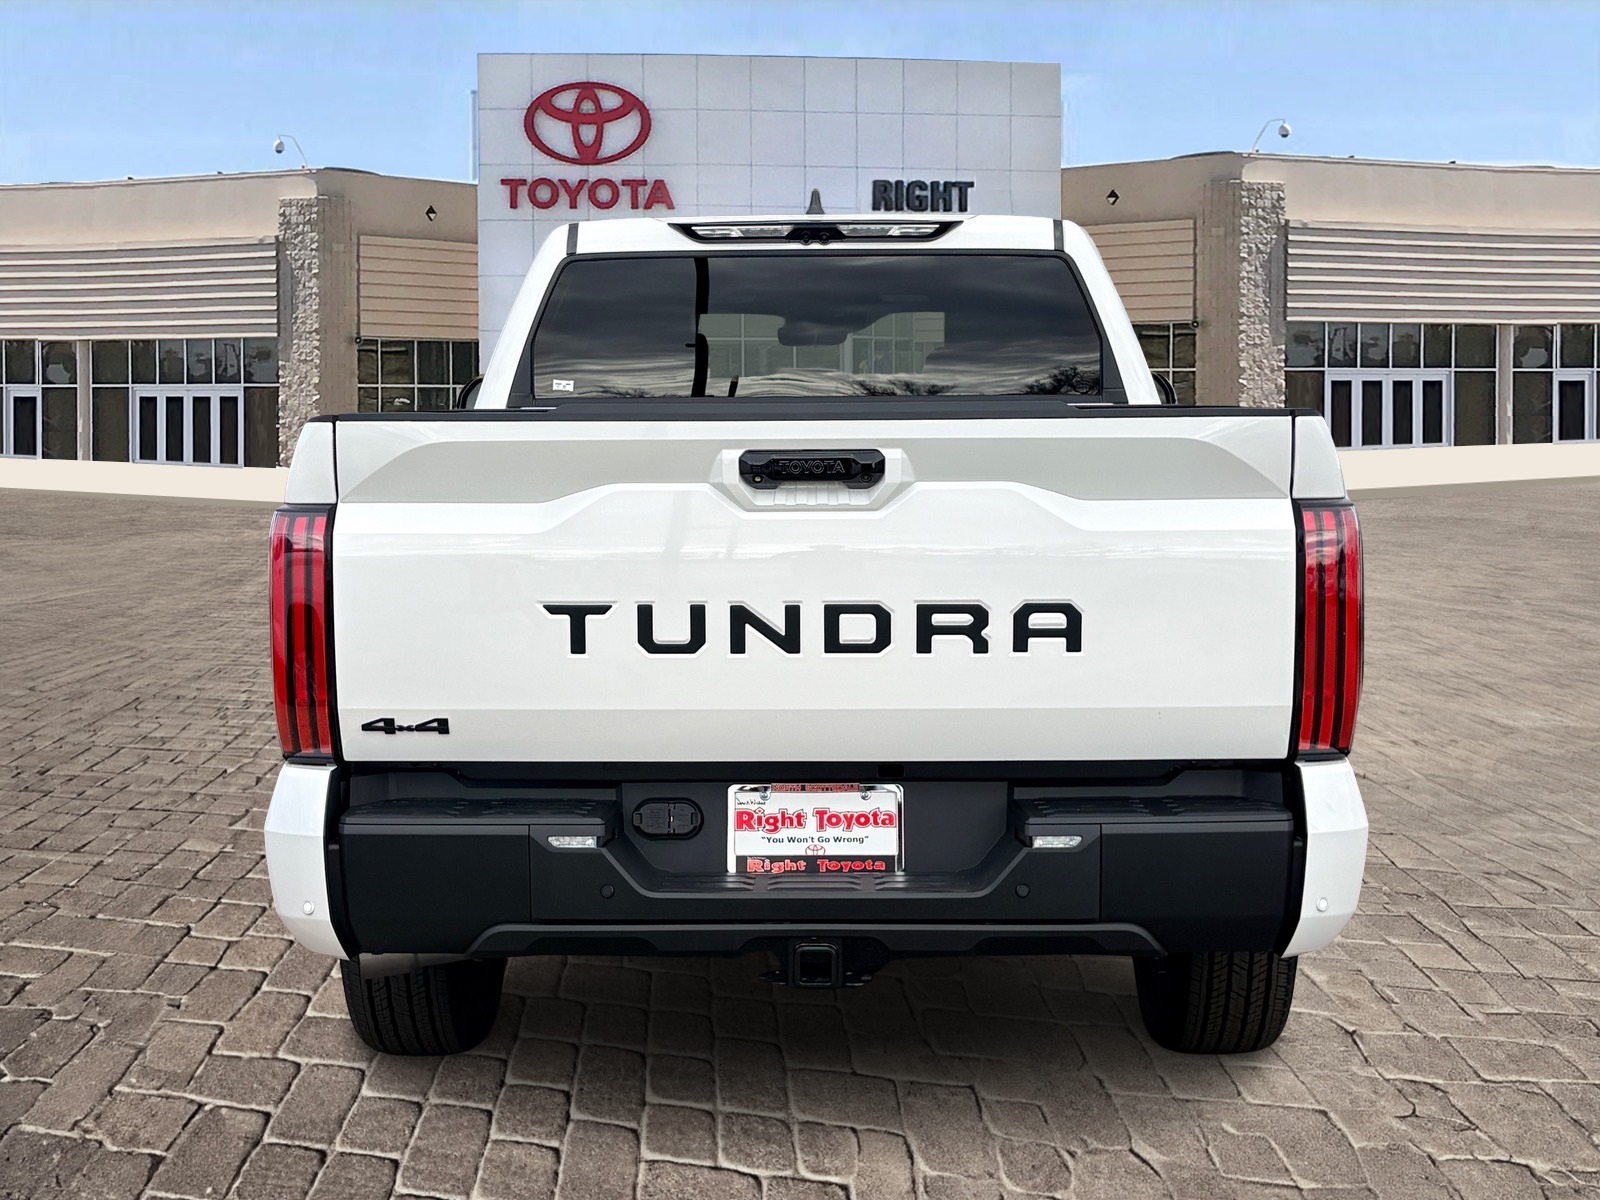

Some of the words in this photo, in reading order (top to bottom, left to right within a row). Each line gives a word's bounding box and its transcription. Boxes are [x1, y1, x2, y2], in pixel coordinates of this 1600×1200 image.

[501, 178, 675, 211] TOYOTA
[871, 180, 975, 213] RIGHT
[778, 460, 846, 474] TOYOTA
[541, 601, 1085, 657] TUNDRA
[735, 807, 807, 834] Right
[813, 807, 897, 832] Toyota
[817, 835, 831, 843] Go
[746, 859, 807, 874] Right
[816, 859, 886, 873] Toyota
